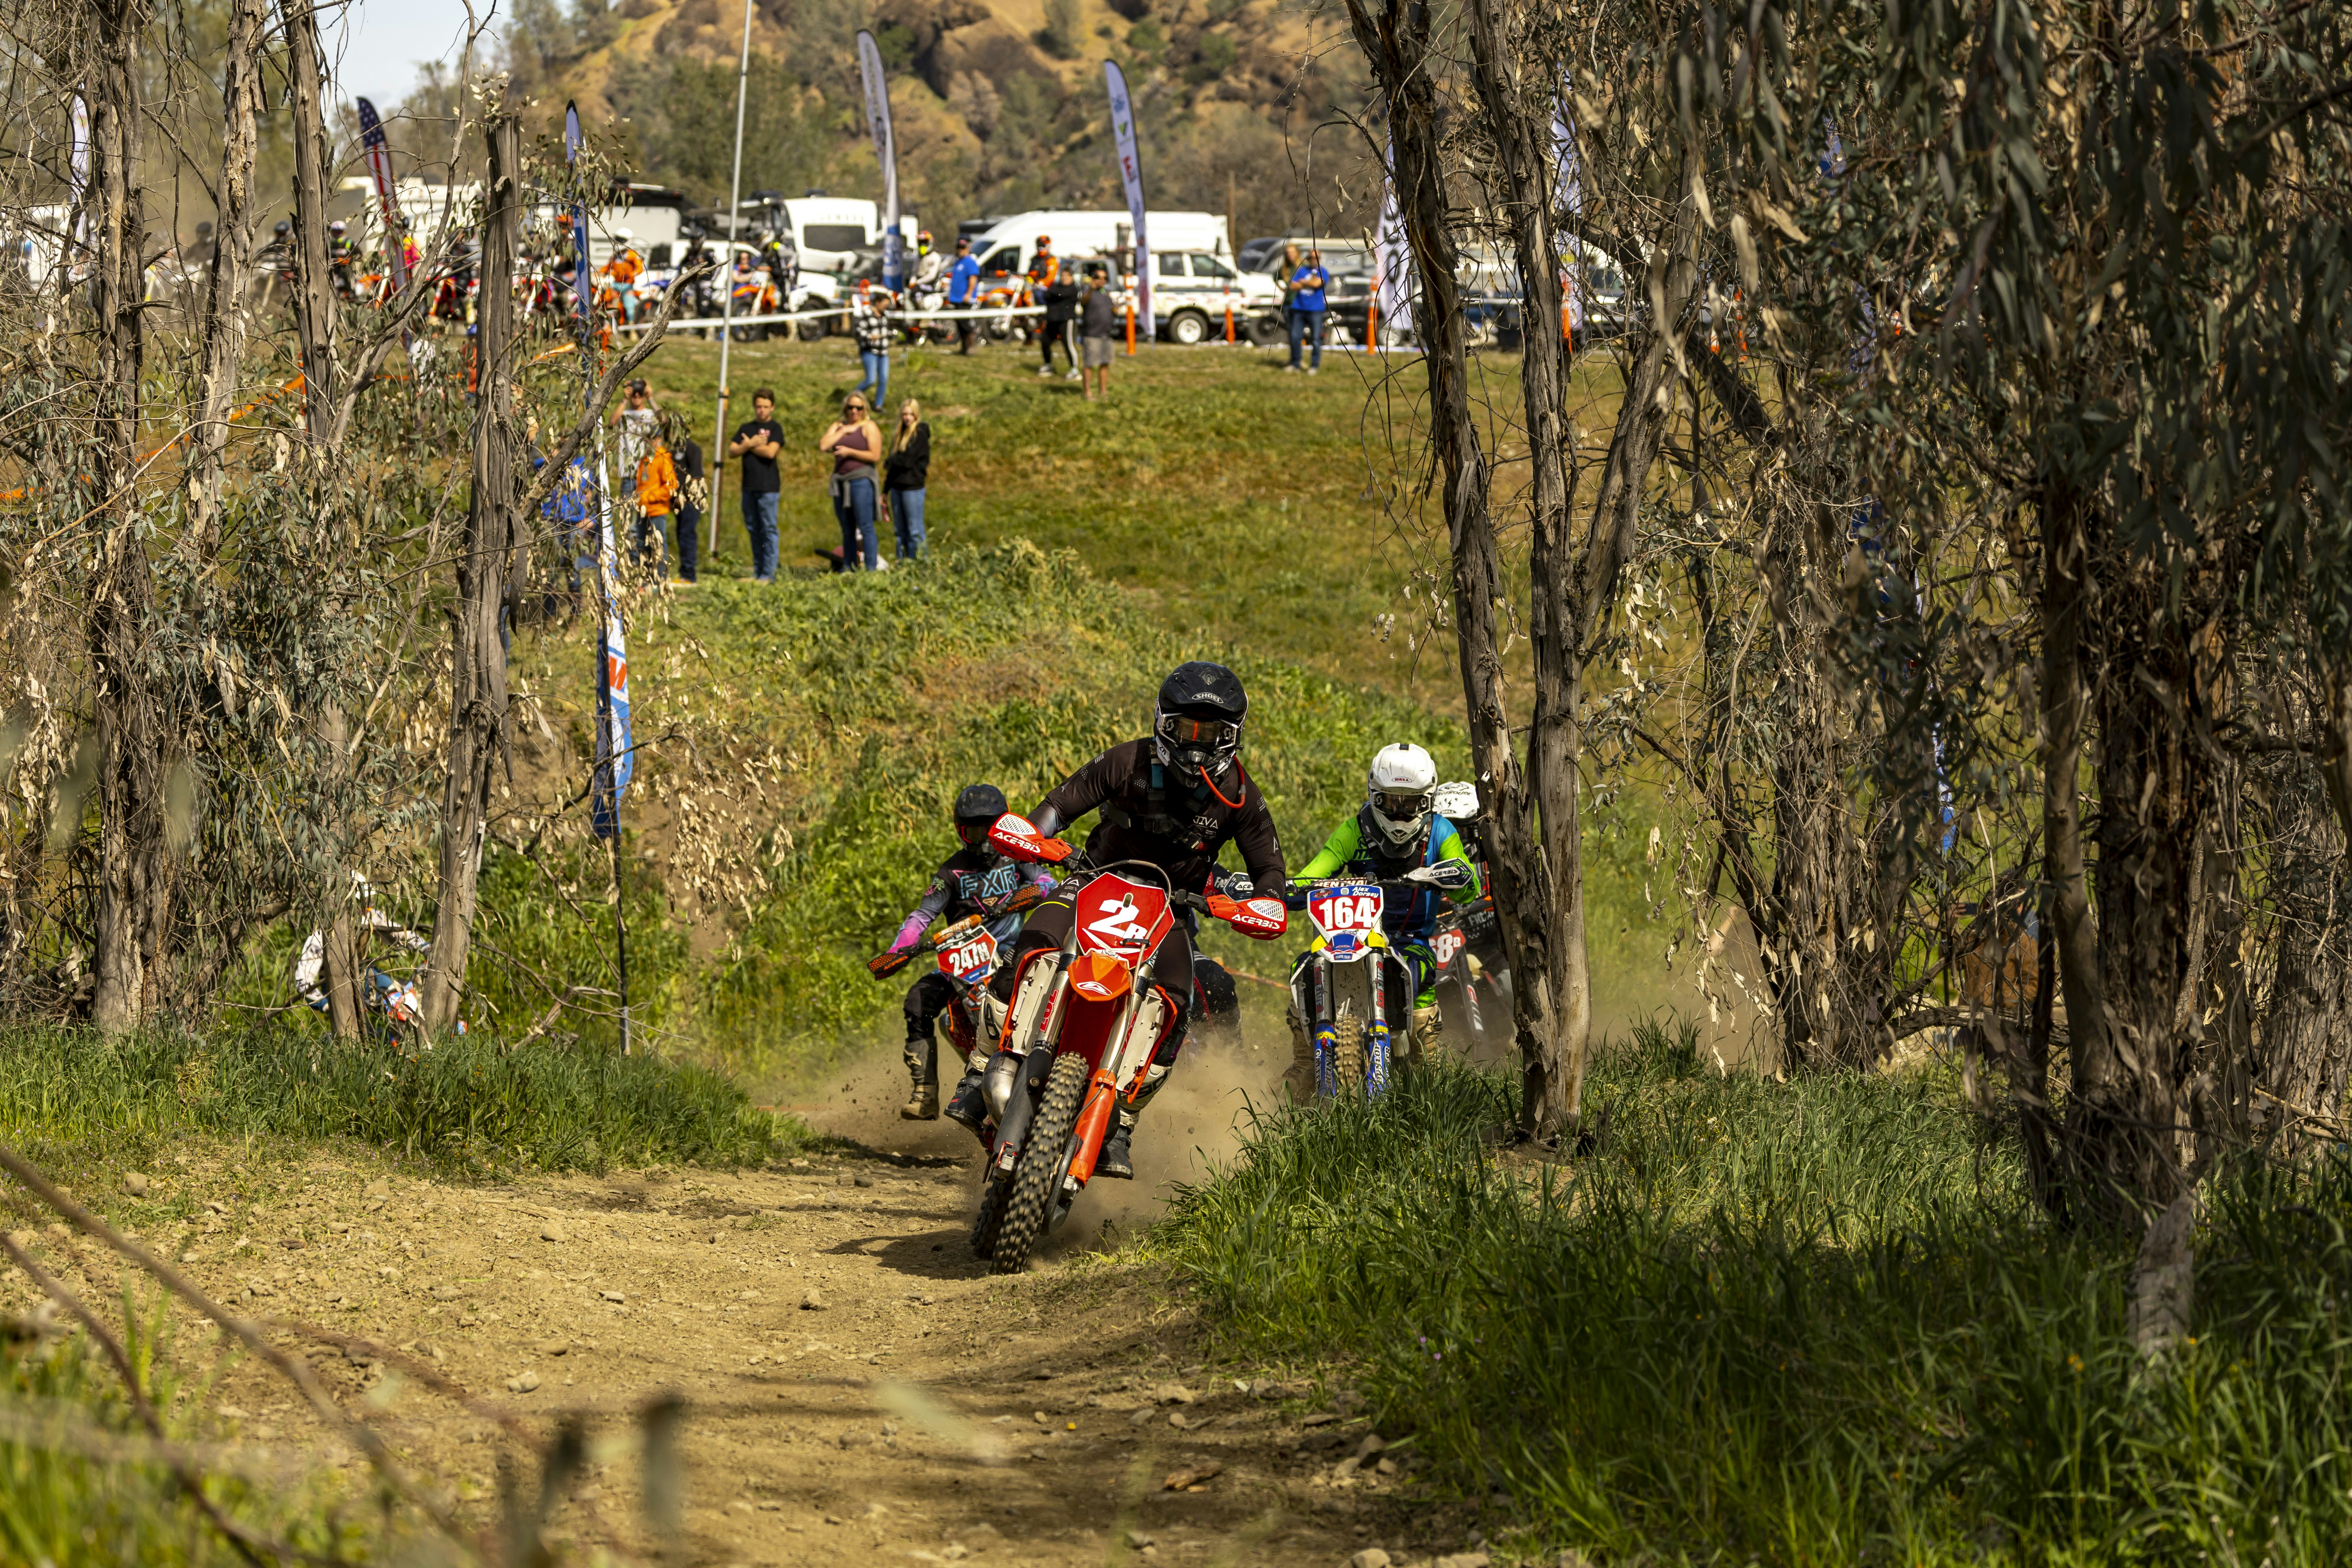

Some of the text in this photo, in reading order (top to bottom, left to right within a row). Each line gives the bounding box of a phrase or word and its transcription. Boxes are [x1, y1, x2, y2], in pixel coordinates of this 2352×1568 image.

[1196, 693, 1220, 702] SHOEI
[994, 832, 1041, 853] ACERBIS
[960, 864, 1017, 899] FXR
[1088, 899, 1140, 938] 2
[1231, 914, 1280, 929] ACERBIS
[1319, 897, 1374, 930] 164
